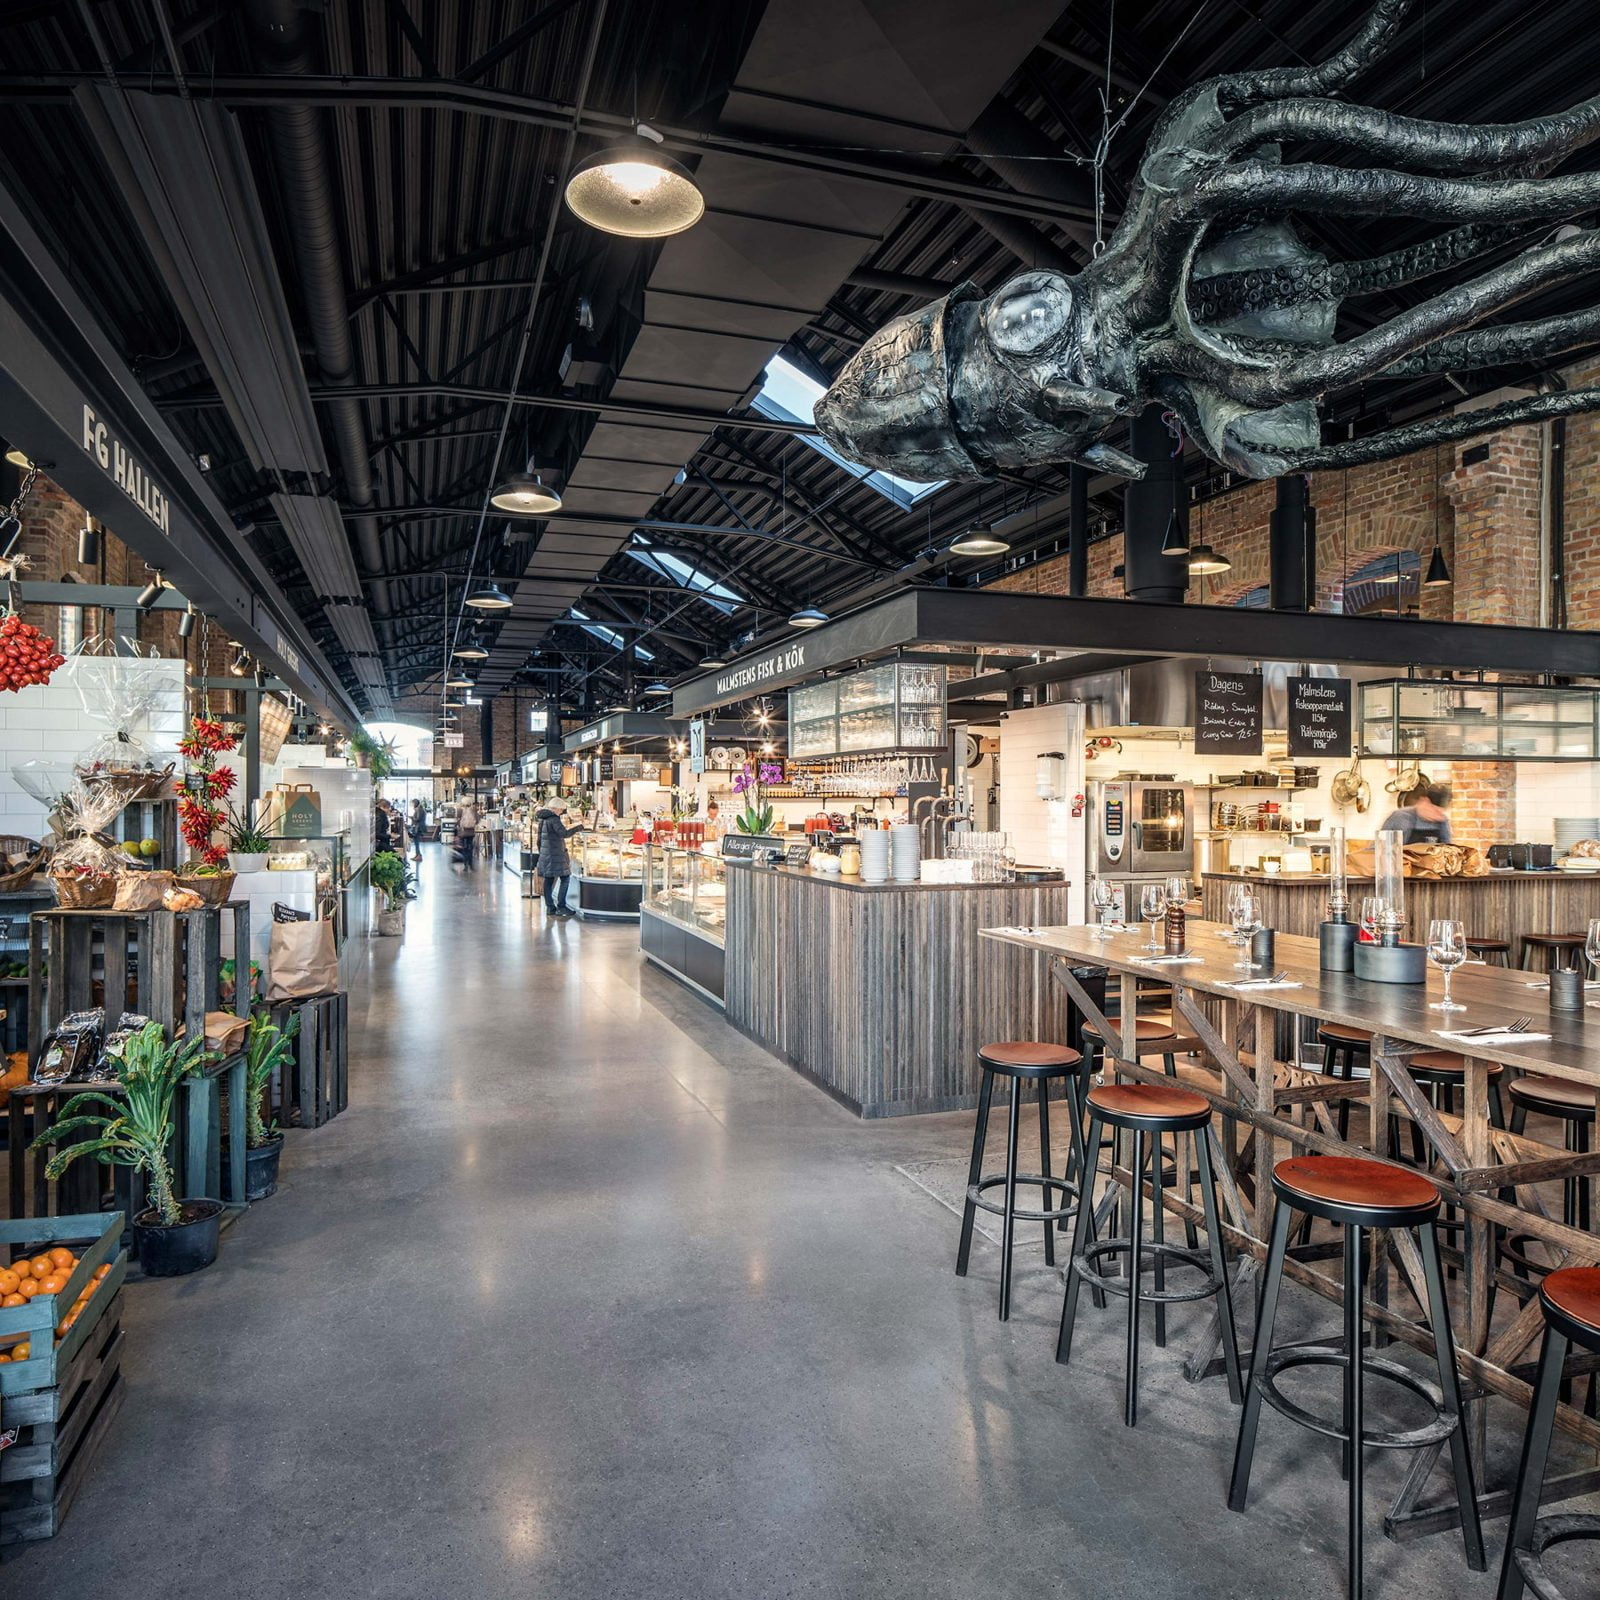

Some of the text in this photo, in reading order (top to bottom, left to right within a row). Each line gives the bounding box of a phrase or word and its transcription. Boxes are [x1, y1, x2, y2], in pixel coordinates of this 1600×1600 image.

[83, 404, 169, 536] FG HALLEN
[716, 644, 805, 695] MALMSTENS FISK & KÖK
[1210, 675, 1244, 694] Dagens
[1299, 683, 1336, 698] Malmstens
